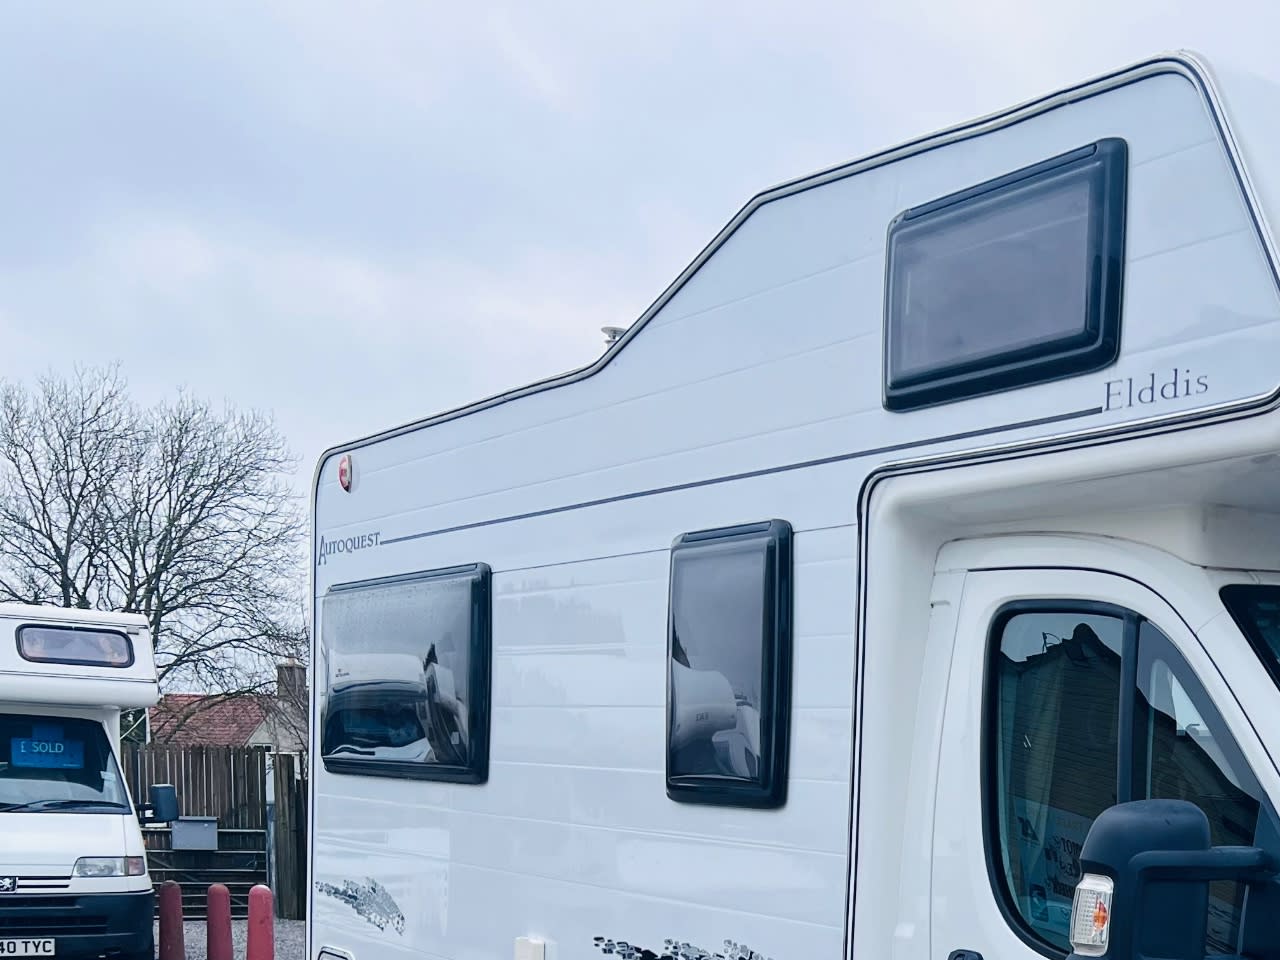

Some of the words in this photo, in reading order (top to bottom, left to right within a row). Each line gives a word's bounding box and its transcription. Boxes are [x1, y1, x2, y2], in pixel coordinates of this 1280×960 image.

[1104, 368, 1209, 412] Elddis
[317, 531, 381, 566] AUTOQUEST
[31, 742, 65, 754] SOLD
[21, 940, 53, 954] TYC
